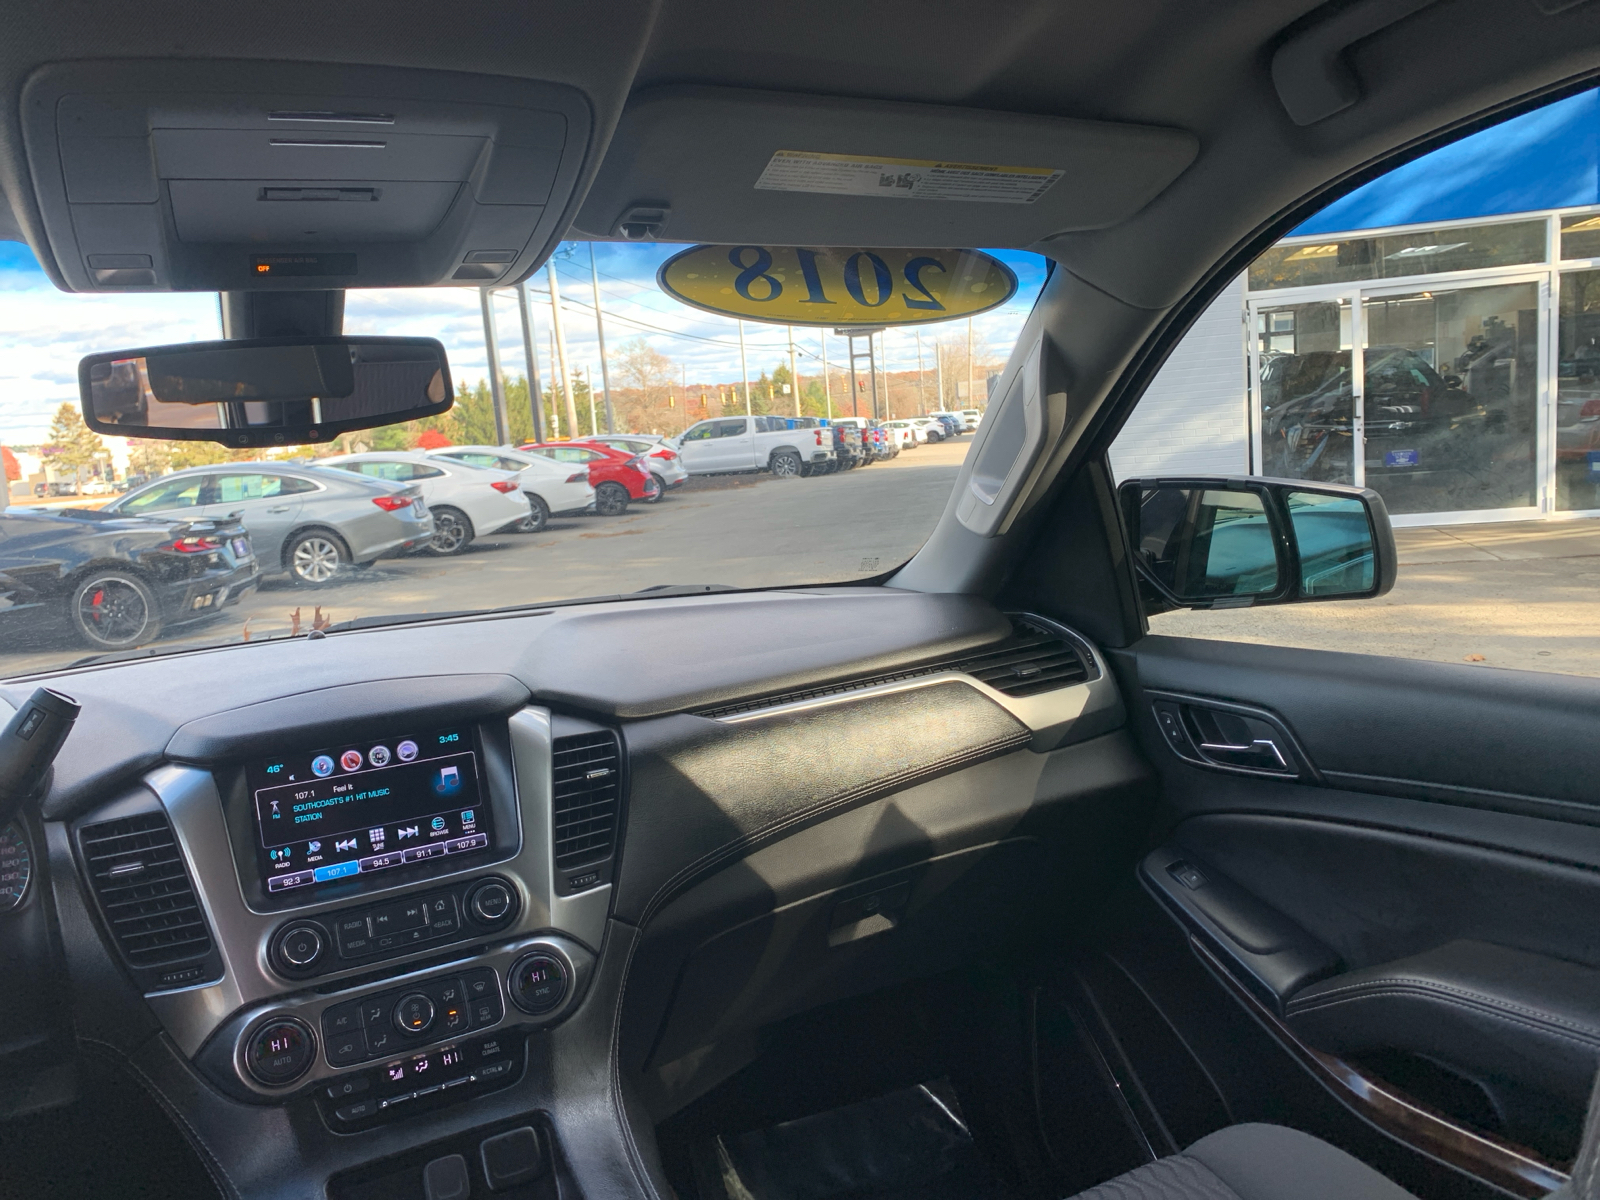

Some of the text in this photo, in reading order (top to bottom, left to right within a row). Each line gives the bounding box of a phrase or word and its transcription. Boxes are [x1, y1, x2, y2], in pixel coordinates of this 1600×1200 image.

[439, 733, 459, 744] 3:45
[294, 790, 315, 800] 107.1
[333, 784, 347, 793] Feel
[345, 794, 354, 803] #1
[355, 792, 367, 801] HIT
[368, 788, 390, 799] MUSIC
[294, 812, 323, 824] STATION
[462, 823, 476, 831] MENU
[429, 829, 449, 837] BROWSE
[456, 839, 476, 849] 107.9
[416, 849, 432, 858] 91.1
[275, 861, 291, 869] RADIO
[372, 858, 390, 867] 94.5
[327, 867, 347, 877] 107.1
[282, 876, 301, 887] 92.3
[485, 898, 502, 906] MENU
[343, 920, 363, 930] RADIO
[347, 939, 366, 949] MEDIA
[535, 986, 550, 996] SYNC
[336, 1016, 348, 1026] A/C
[483, 1041, 497, 1049] REAR
[481, 1046, 501, 1056] CLIMATE
[273, 1055, 292, 1067] AUTO
[351, 1105, 365, 1114] AUTO
